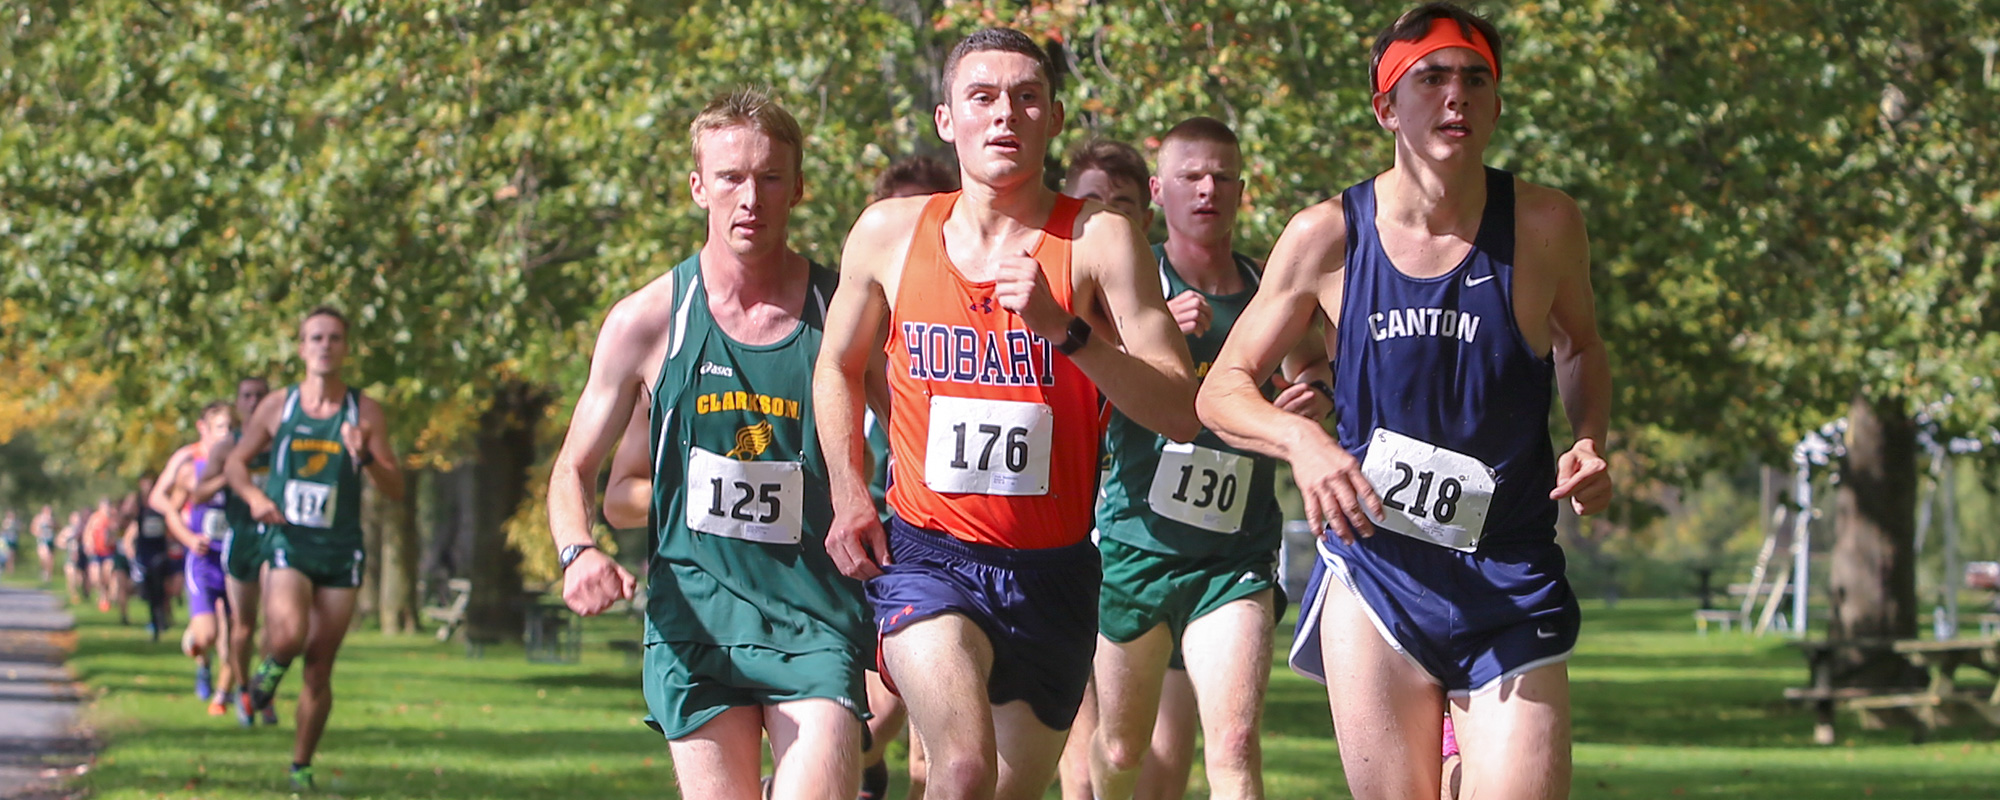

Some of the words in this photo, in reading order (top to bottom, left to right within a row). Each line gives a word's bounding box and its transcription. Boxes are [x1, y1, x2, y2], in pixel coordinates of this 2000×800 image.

[1368, 307, 1480, 343] CANTON
[903, 321, 1054, 386] HOBART
[697, 391, 799, 419] CLARKSON
[950, 422, 1029, 473] 176
[708, 478, 782, 524] 125
[1173, 464, 1235, 512] 130
[1383, 461, 1462, 523] 218
